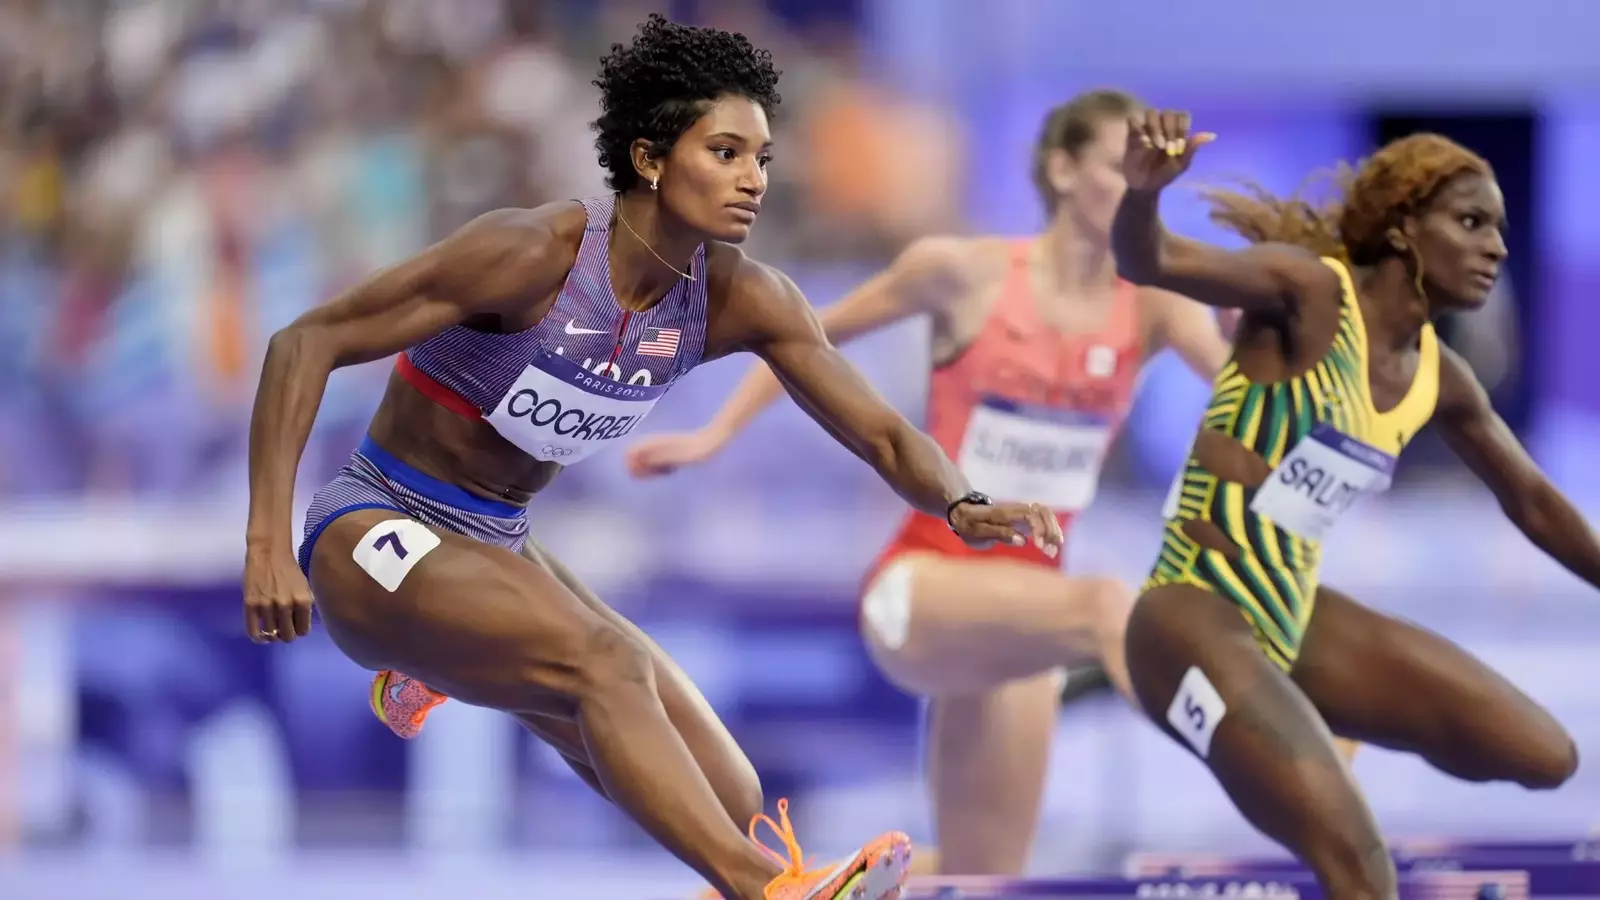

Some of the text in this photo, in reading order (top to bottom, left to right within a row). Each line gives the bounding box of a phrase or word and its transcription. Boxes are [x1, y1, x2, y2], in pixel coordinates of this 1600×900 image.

[575, 372, 646, 397] PARIS 2024
[373, 530, 409, 560] 7
[1184, 693, 1206, 731] 5
